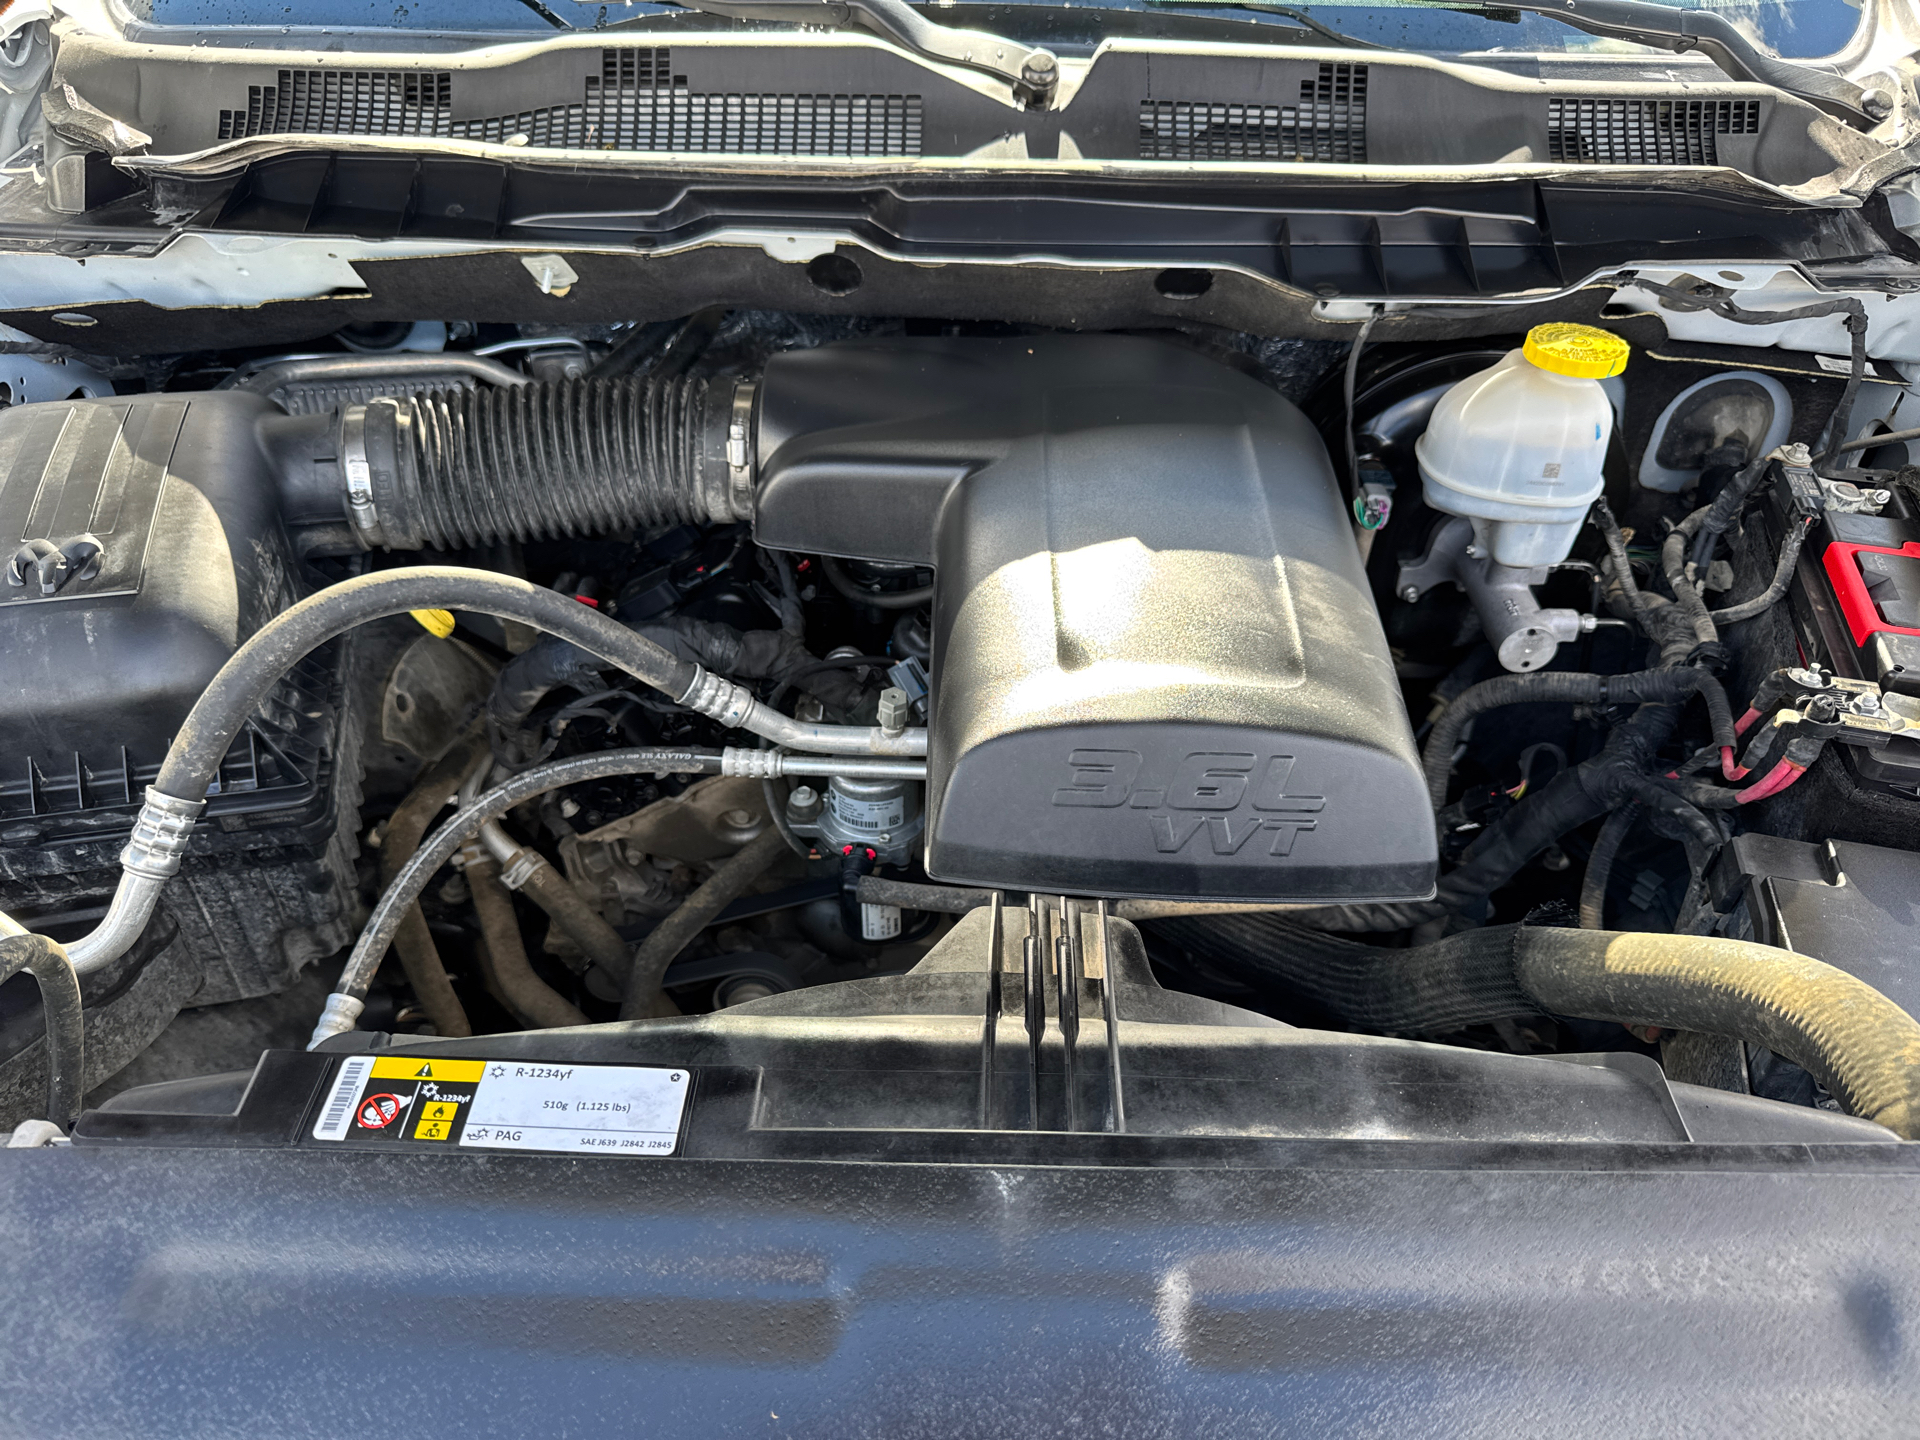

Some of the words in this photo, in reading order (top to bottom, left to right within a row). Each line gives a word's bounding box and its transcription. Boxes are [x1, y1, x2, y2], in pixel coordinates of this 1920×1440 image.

[597, 755, 614, 763] HOSE
[655, 752, 692, 760] GALAXY
[1051, 748, 1327, 813] 3.6L
[1150, 815, 1318, 857] VVT
[515, 1067, 574, 1081] R-1234yf
[433, 1094, 471, 1104] R-1234yf
[543, 1101, 569, 1111] 510g
[576, 1101, 610, 1112] (1.125
[611, 1102, 632, 1114] lbs)
[495, 1131, 523, 1141] PAG
[580, 1138, 596, 1146] SAE
[597, 1138, 617, 1147] J639
[620, 1139, 645, 1148] J2842
[648, 1141, 672, 1149] J2845
